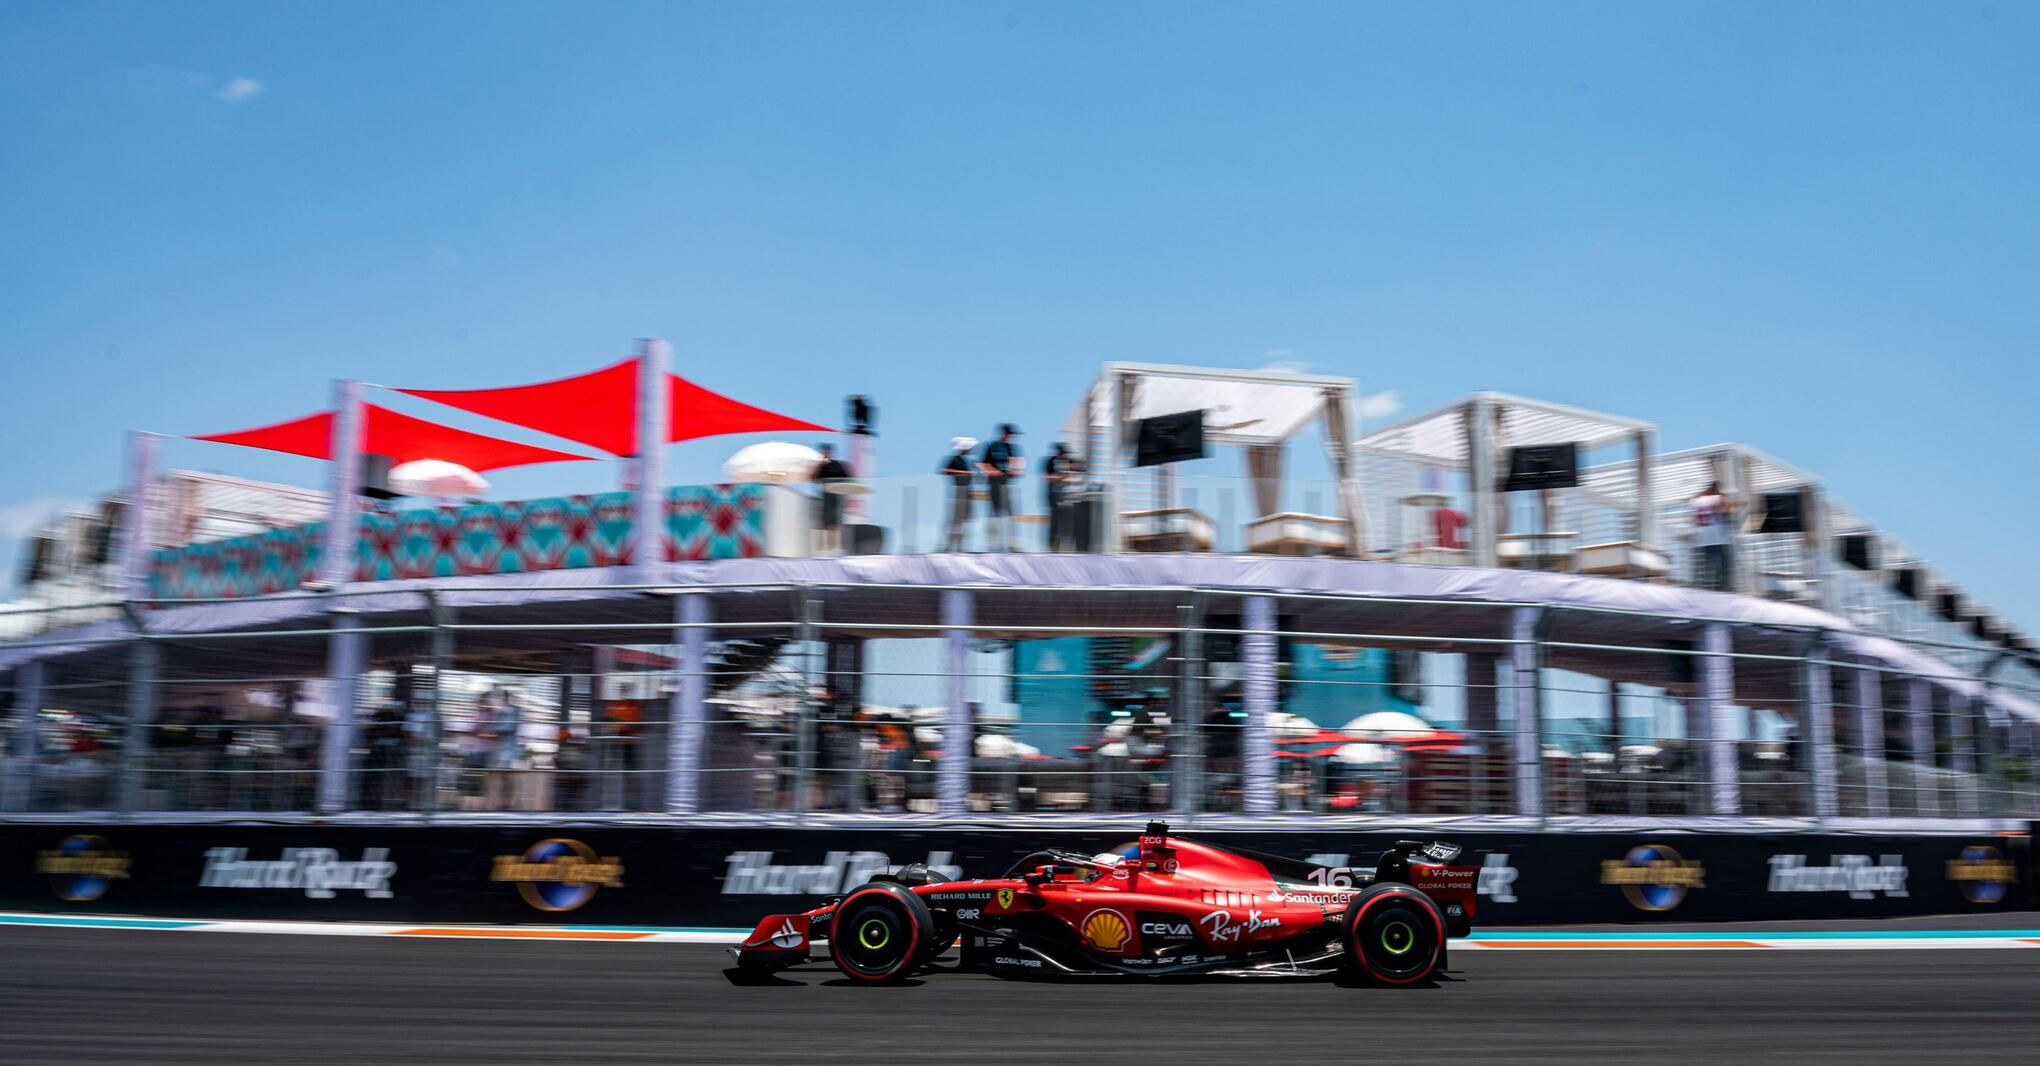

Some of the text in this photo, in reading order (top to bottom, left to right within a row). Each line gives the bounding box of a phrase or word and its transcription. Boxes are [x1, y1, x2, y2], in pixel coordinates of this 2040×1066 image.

[1143, 836, 1162, 844] ZCG
[1307, 867, 1353, 889] 16
[1431, 869, 1474, 877] V-Power
[1284, 891, 1353, 904] Santander
[810, 913, 833, 924] Santa
[1199, 909, 1281, 942] Ray-Ban
